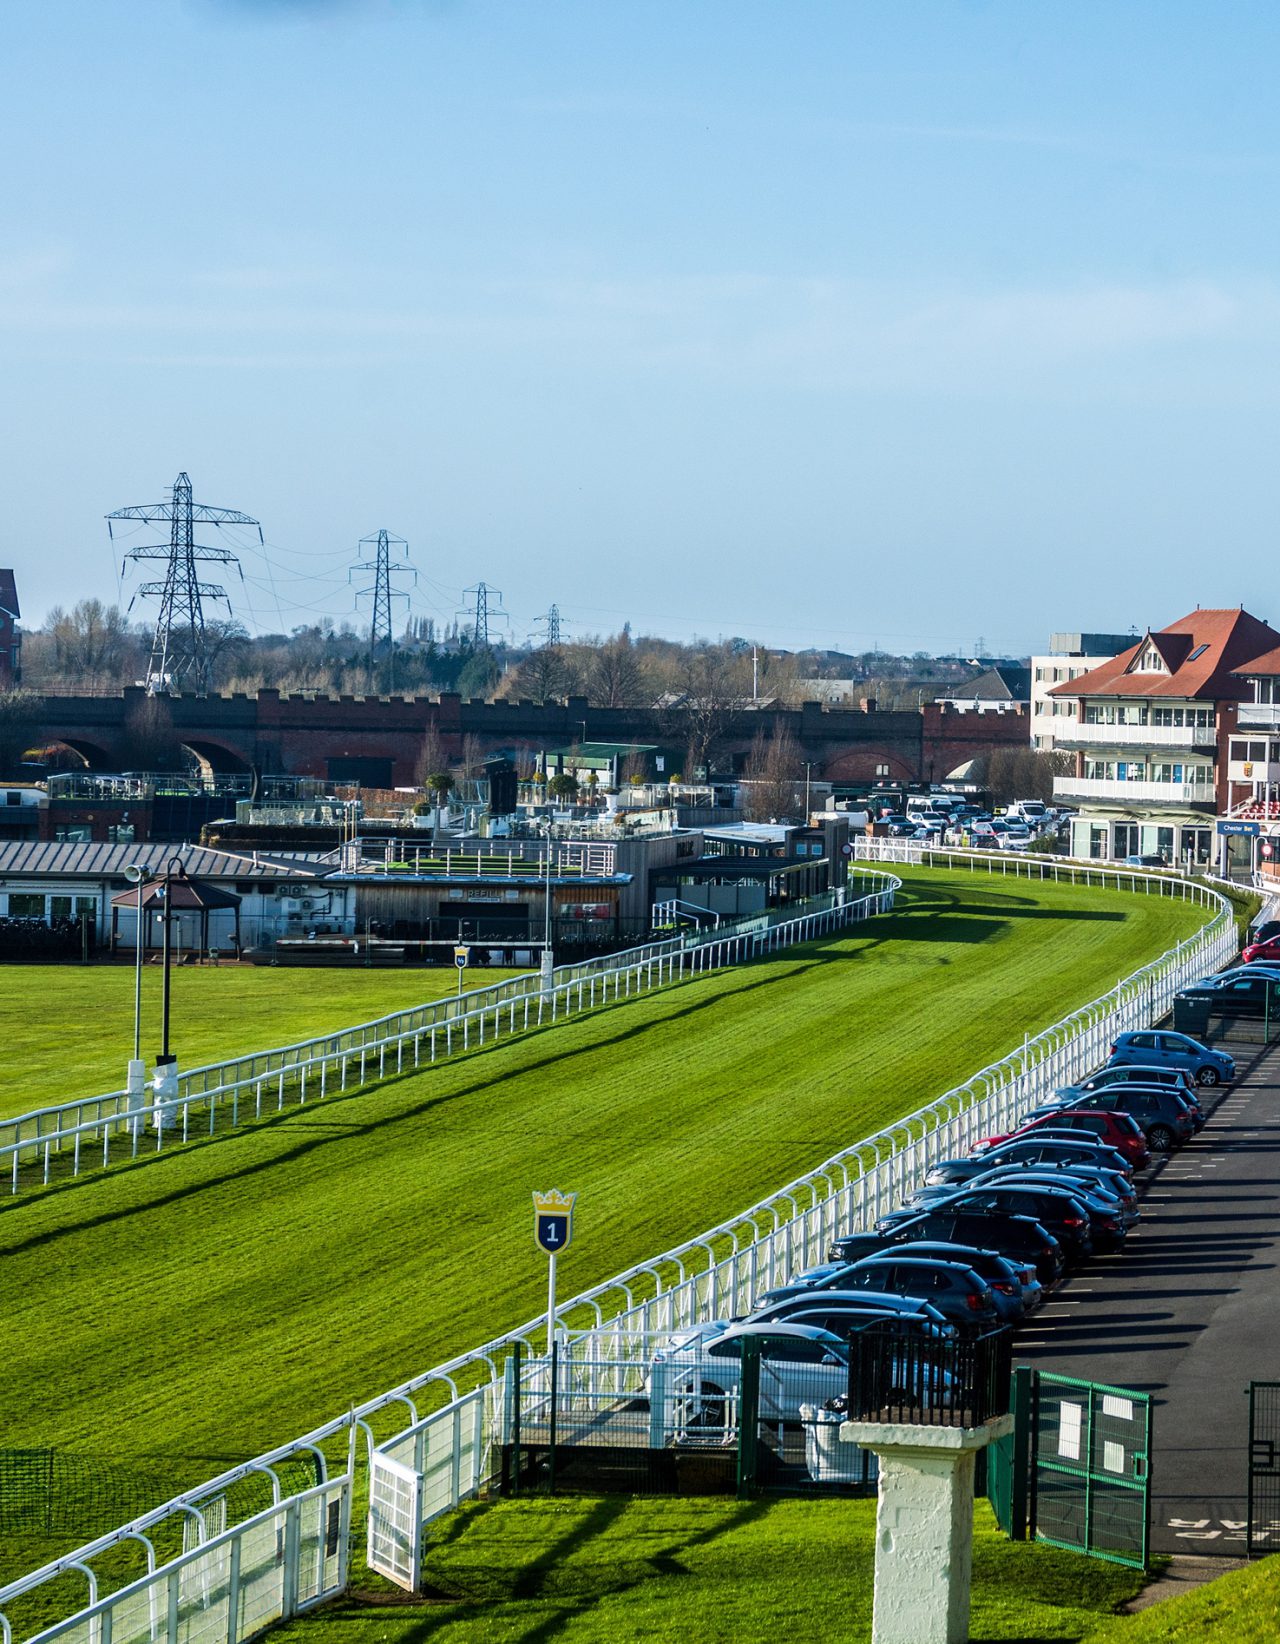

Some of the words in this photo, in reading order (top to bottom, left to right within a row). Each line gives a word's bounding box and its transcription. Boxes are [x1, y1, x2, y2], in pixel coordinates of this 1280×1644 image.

[1223, 824, 1243, 832] Chester
[468, 889, 502, 898] REFILL
[546, 1222, 559, 1242] 1
